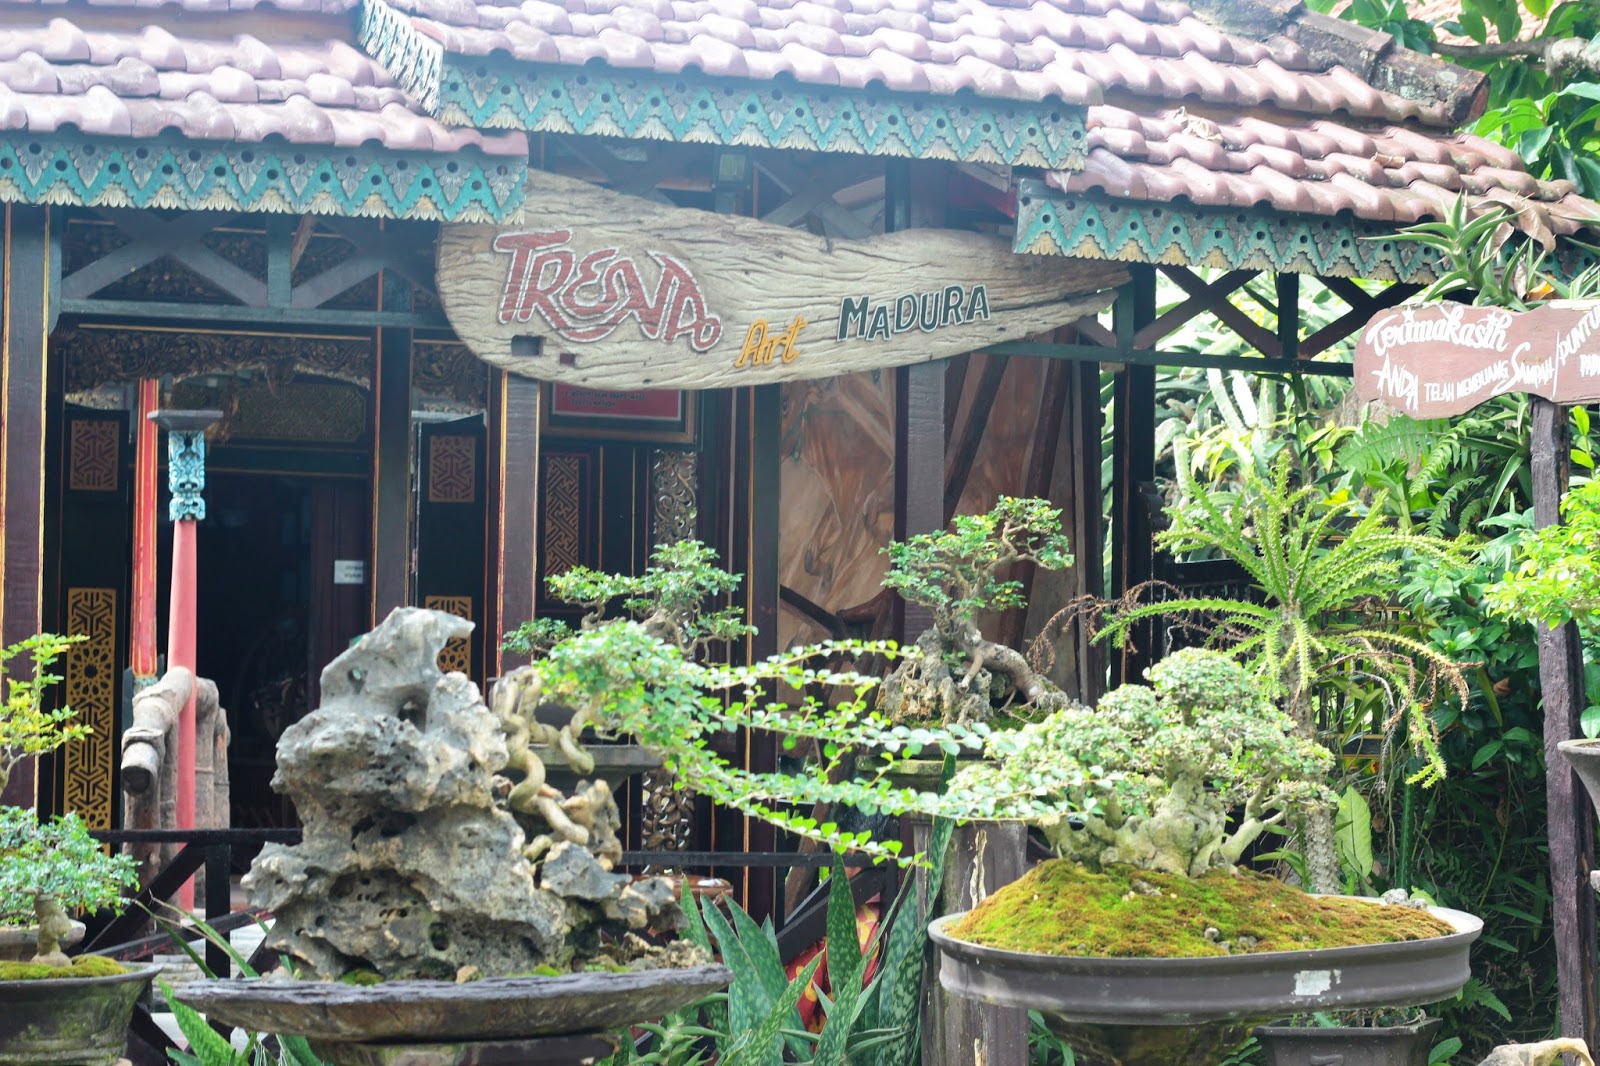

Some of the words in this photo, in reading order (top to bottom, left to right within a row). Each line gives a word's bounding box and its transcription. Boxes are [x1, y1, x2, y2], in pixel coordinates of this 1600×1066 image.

[734, 315, 808, 368] Art
[837, 284, 991, 342] MADURA
[1371, 353, 1419, 412] ANDA
[1424, 382, 1455, 402] TELAH
[1456, 360, 1509, 398] MEMBUANG
